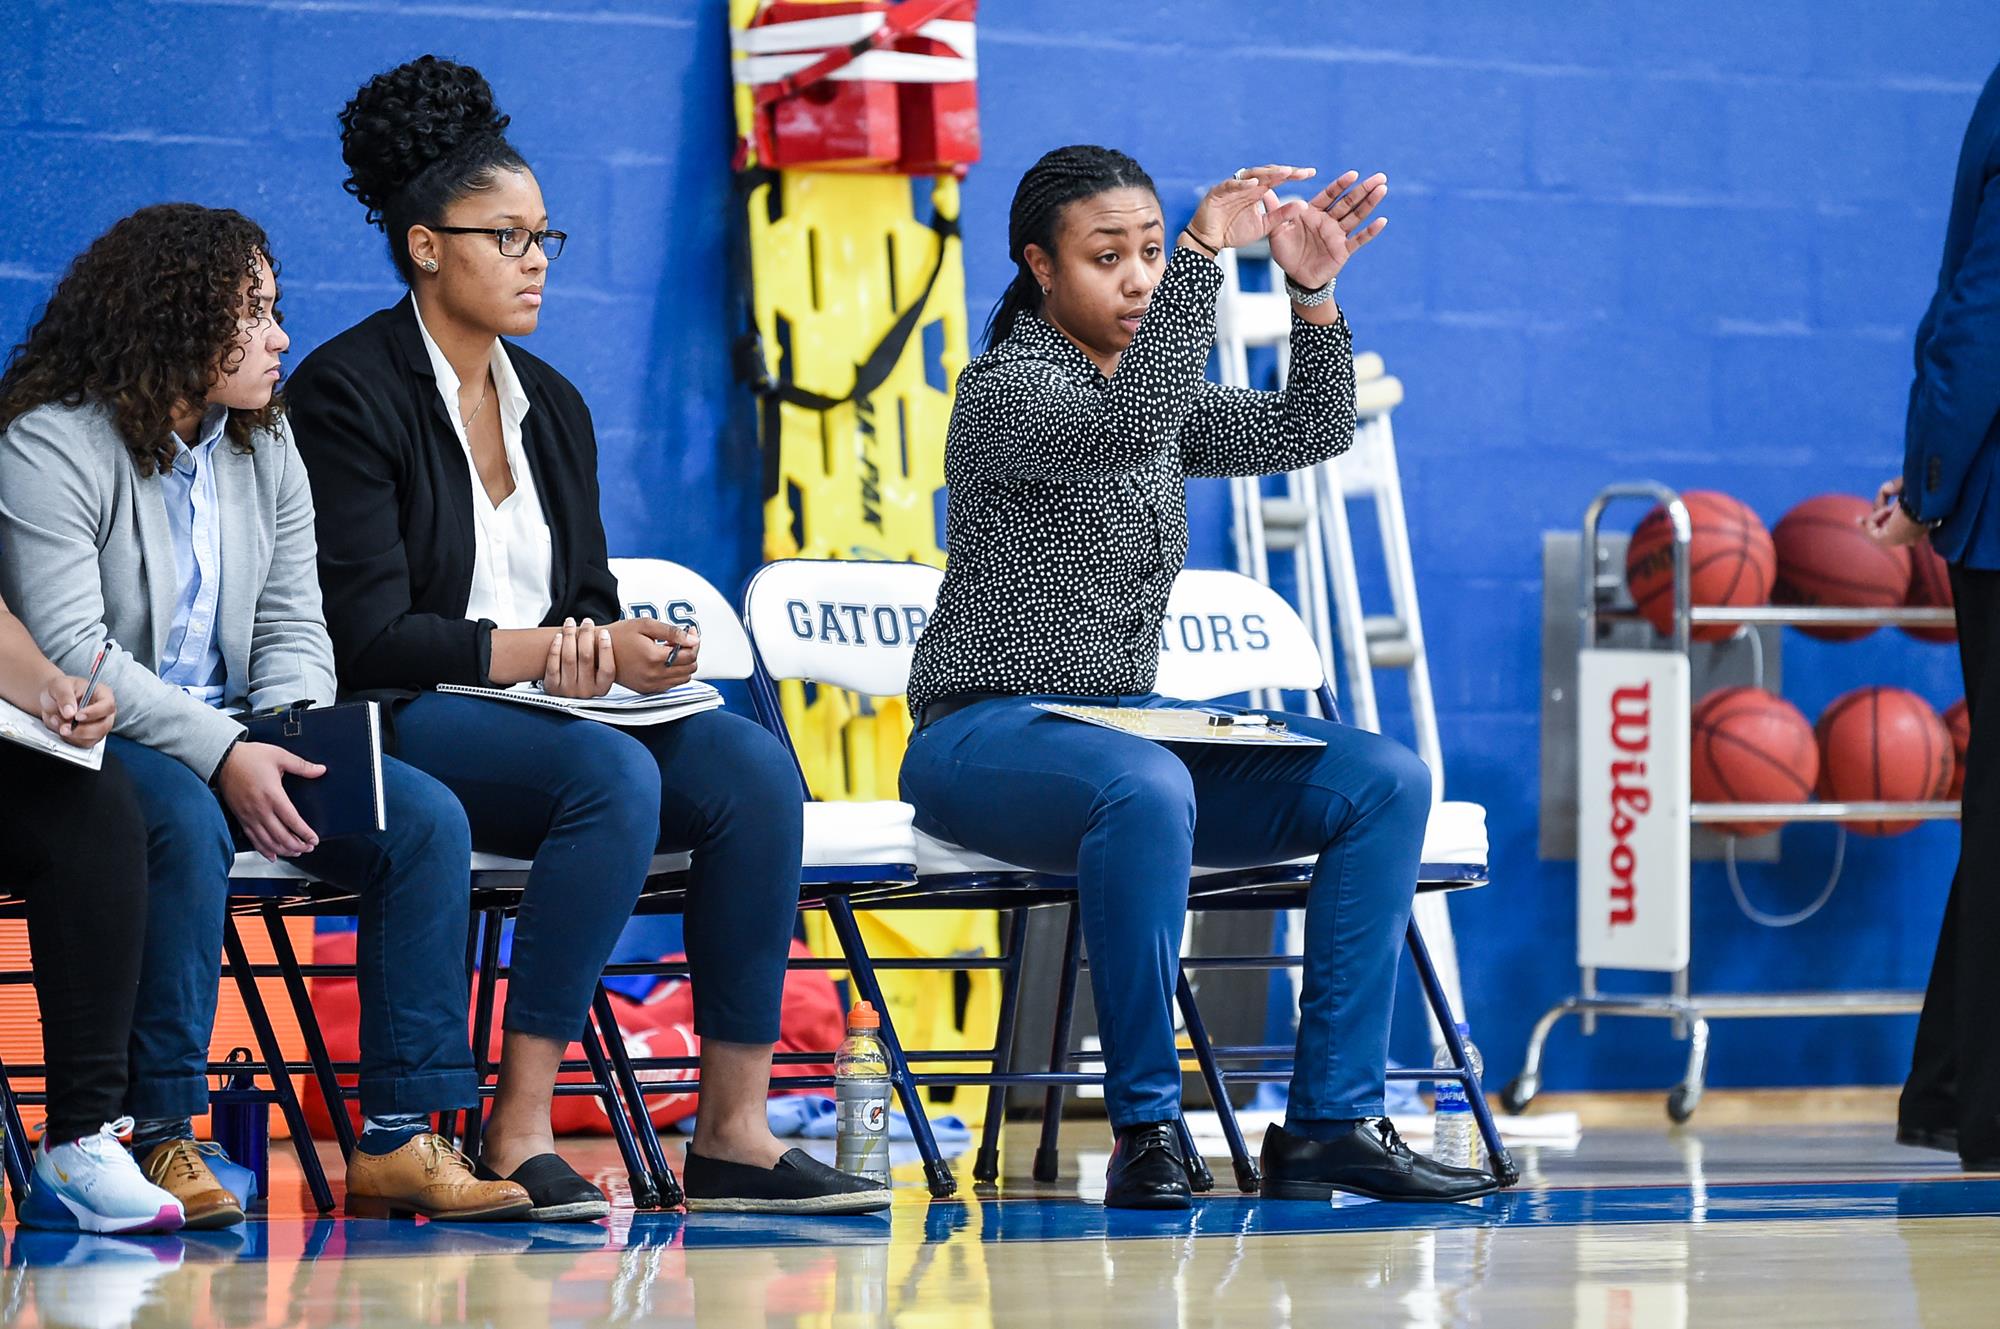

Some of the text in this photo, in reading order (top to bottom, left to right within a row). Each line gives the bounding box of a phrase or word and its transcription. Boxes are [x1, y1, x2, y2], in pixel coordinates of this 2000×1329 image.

[785, 598, 930, 648] GATOR
[1160, 612, 1271, 653] TORS
[1609, 679, 1652, 925] Wilson
